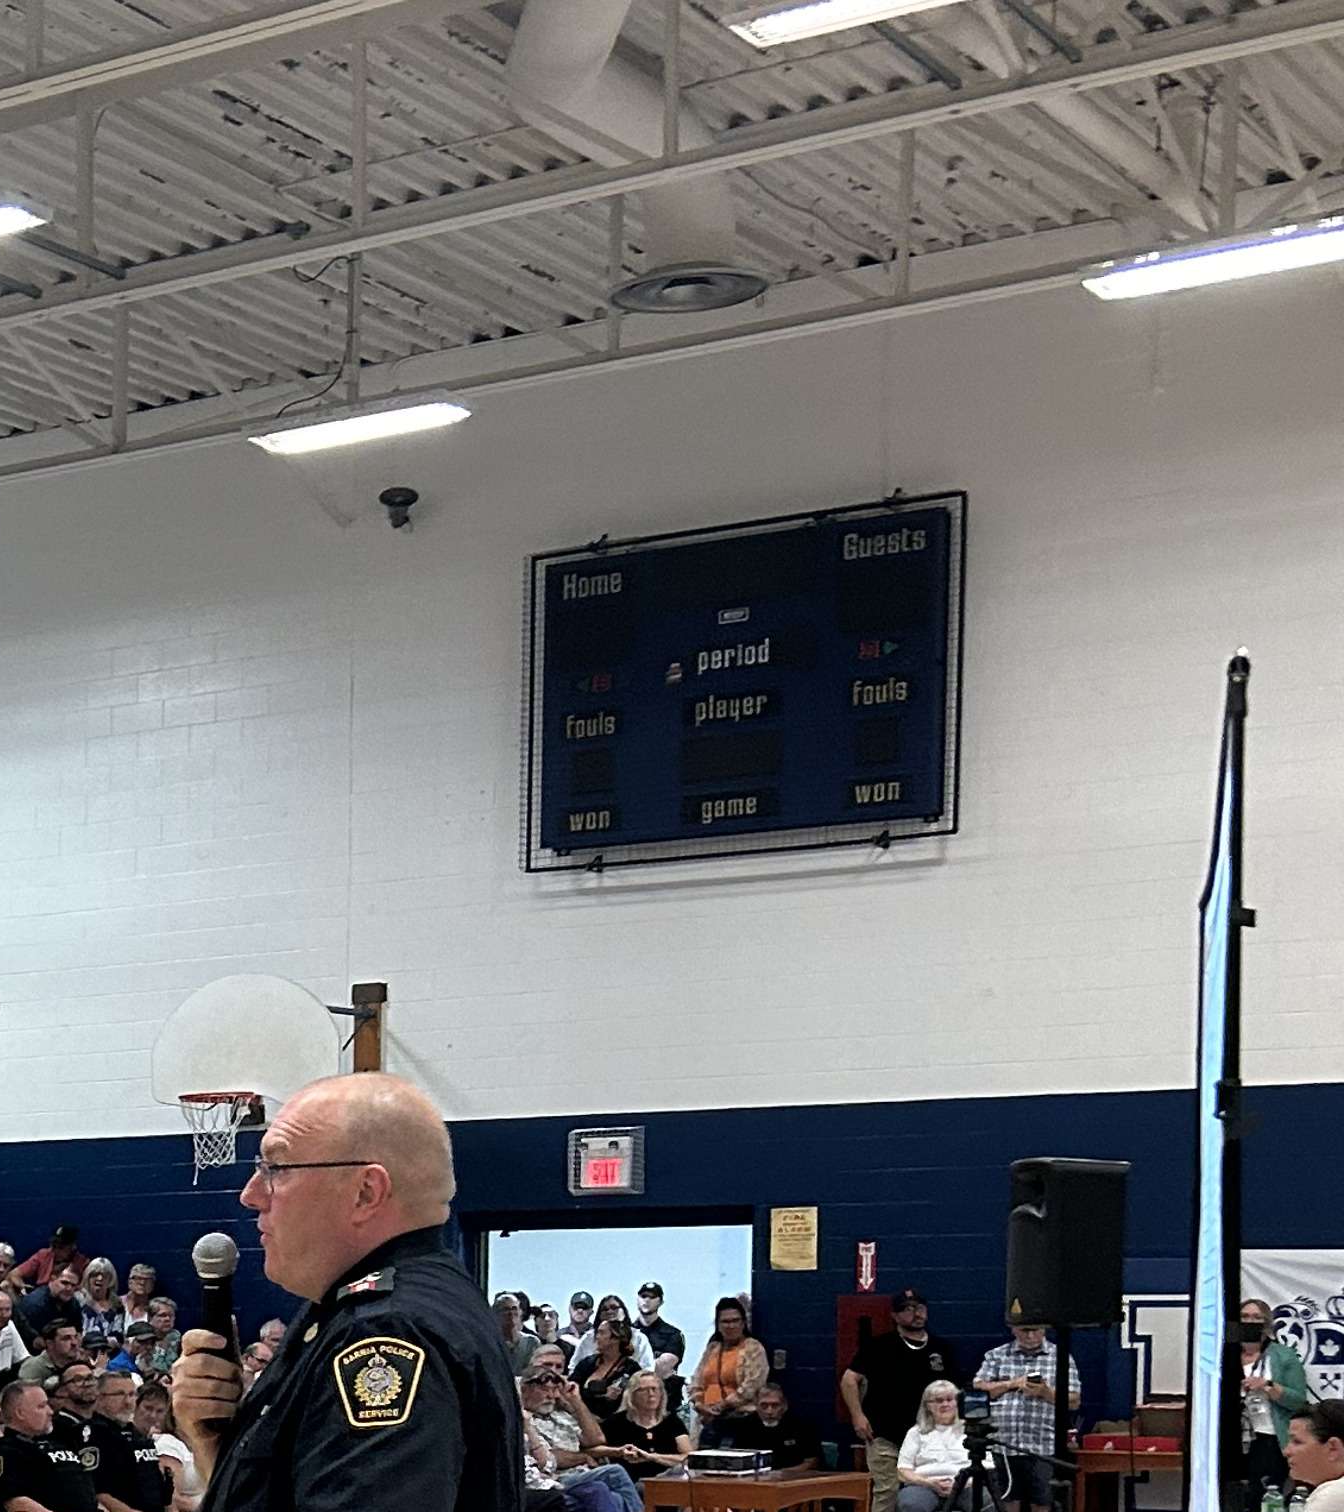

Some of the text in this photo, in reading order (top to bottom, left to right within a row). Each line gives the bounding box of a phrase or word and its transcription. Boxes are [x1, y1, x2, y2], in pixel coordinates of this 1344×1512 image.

[843, 528, 927, 561] Guests
[562, 572, 622, 601] Home
[697, 637, 770, 675] period
[852, 676, 908, 707] fouls
[695, 694, 768, 727] player
[566, 711, 616, 739] fouls
[855, 781, 901, 804] won
[569, 810, 611, 832] won
[701, 796, 758, 824] game
[380, 1345, 416, 1360] POLICE
[358, 1407, 400, 1419] SERVICE
